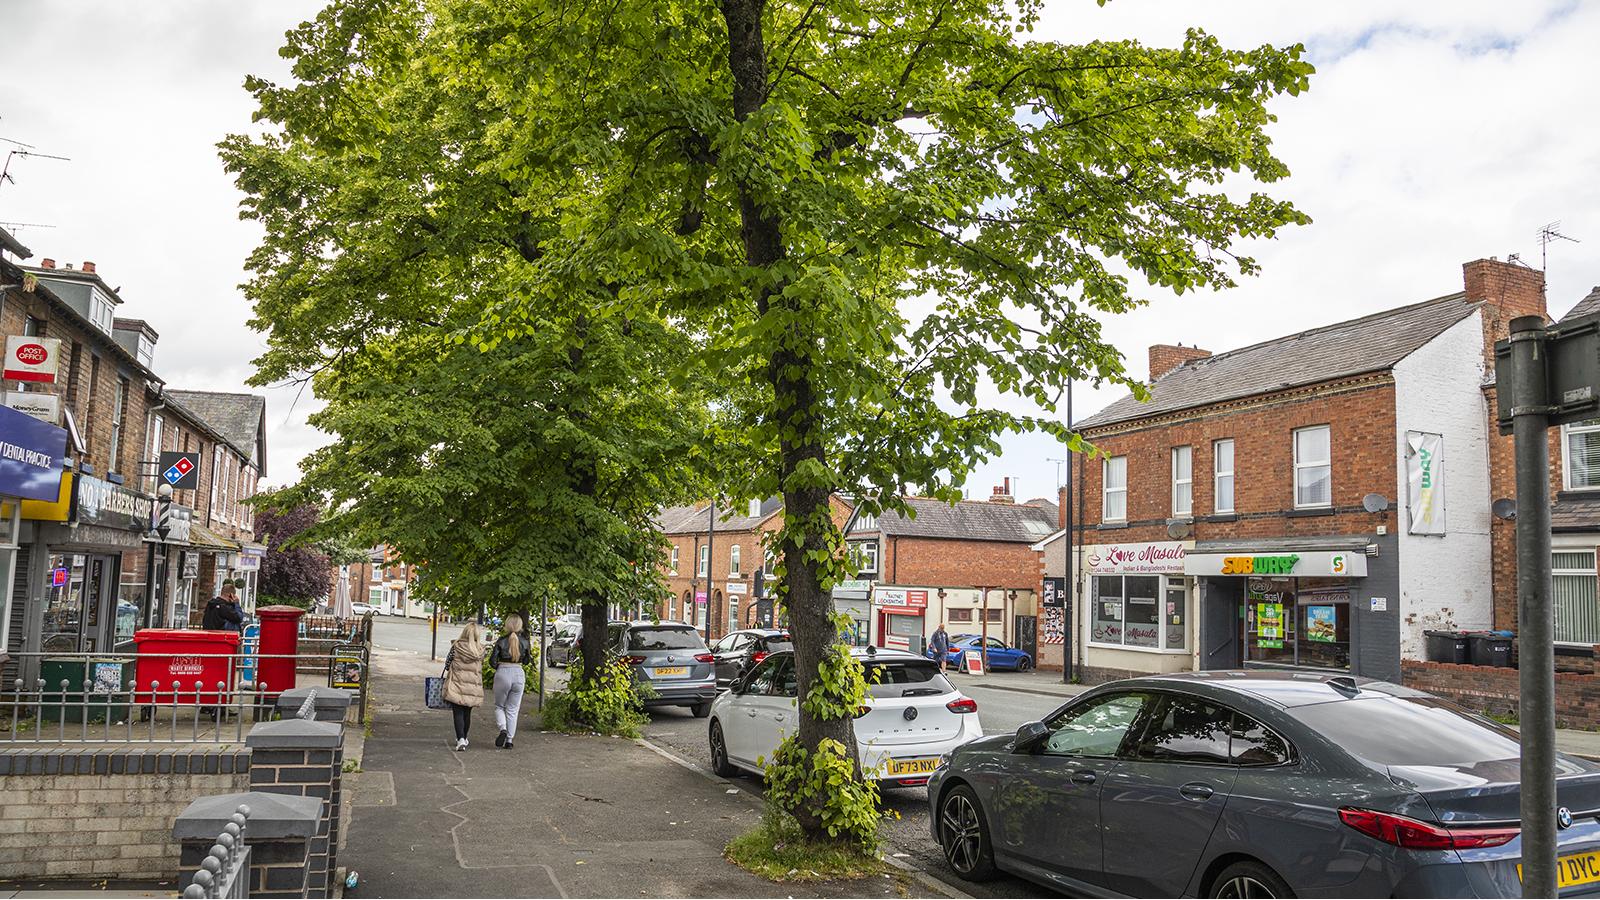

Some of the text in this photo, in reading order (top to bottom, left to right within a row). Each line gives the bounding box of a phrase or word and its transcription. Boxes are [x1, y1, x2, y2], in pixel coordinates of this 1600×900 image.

[18, 352, 44, 361] OFFICE
[23, 347, 42, 355] POST
[12, 404, 50, 412] MoneyGram
[3, 442, 25, 462] DENTAL
[25, 449, 52, 469] PRACTICE
[101, 487, 135, 516] BARBERS
[135, 497, 152, 519] SHOP
[1221, 554, 1299, 574] SUBWAY
[1567, 855, 1599, 880] DYC
